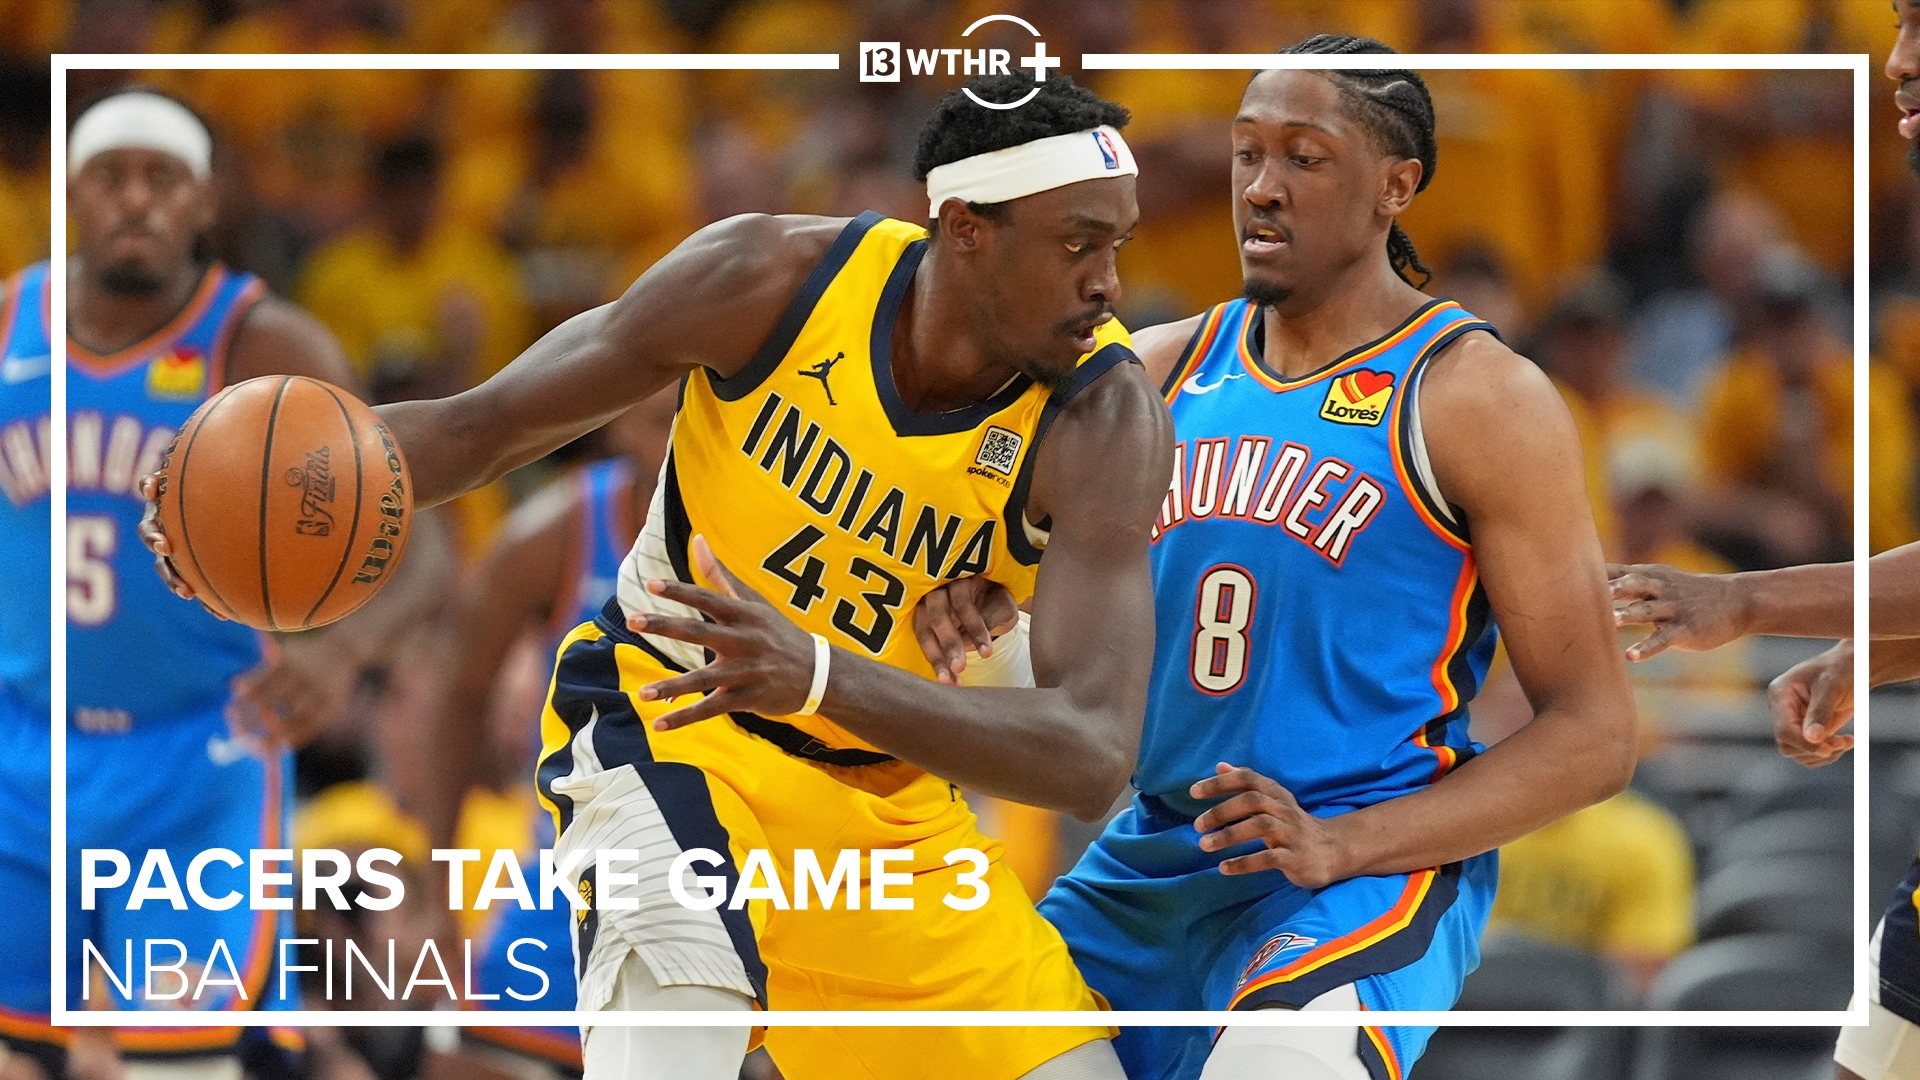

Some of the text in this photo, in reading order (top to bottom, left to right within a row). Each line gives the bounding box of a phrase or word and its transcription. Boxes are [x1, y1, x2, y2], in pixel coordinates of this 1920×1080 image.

[300, 444, 336, 531] Finals
[351, 422, 405, 585] Wilson
[741, 389, 998, 582] INDIANA
[966, 466, 1011, 489] spokenote
[1150, 434, 1387, 568] HUNDER
[759, 522, 907, 657] 43
[1189, 563, 1258, 697] 8
